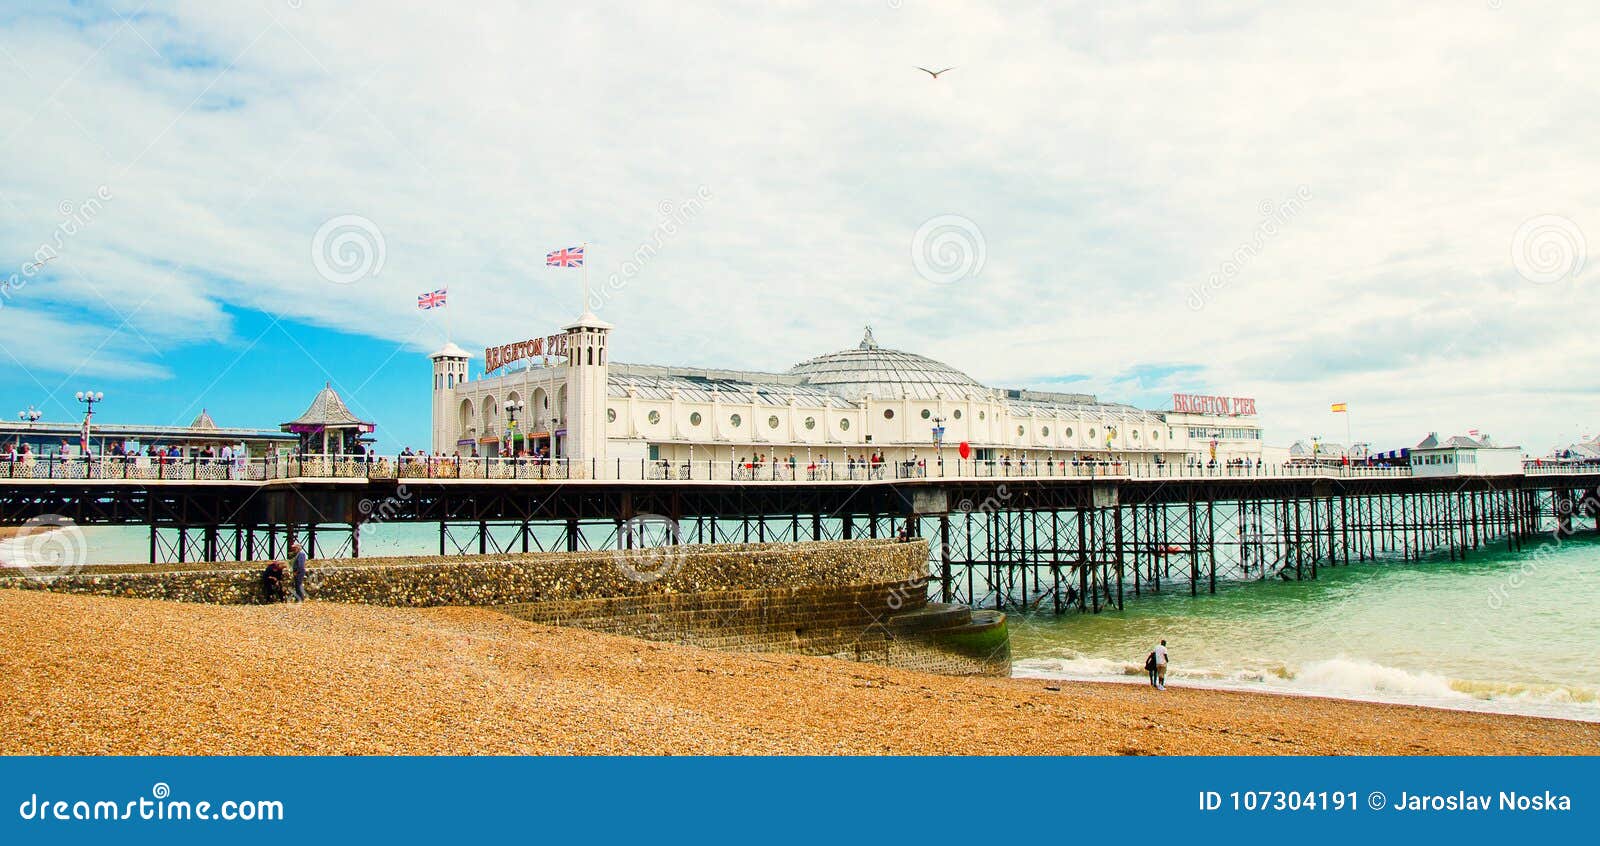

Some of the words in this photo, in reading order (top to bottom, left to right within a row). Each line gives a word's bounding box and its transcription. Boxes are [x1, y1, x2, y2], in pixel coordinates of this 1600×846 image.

[485, 338, 543, 374] BRIGHTON
[547, 332, 568, 357] PIE
[1173, 394, 1229, 414] BRIGHTON
[1232, 397, 1257, 415] PIER
